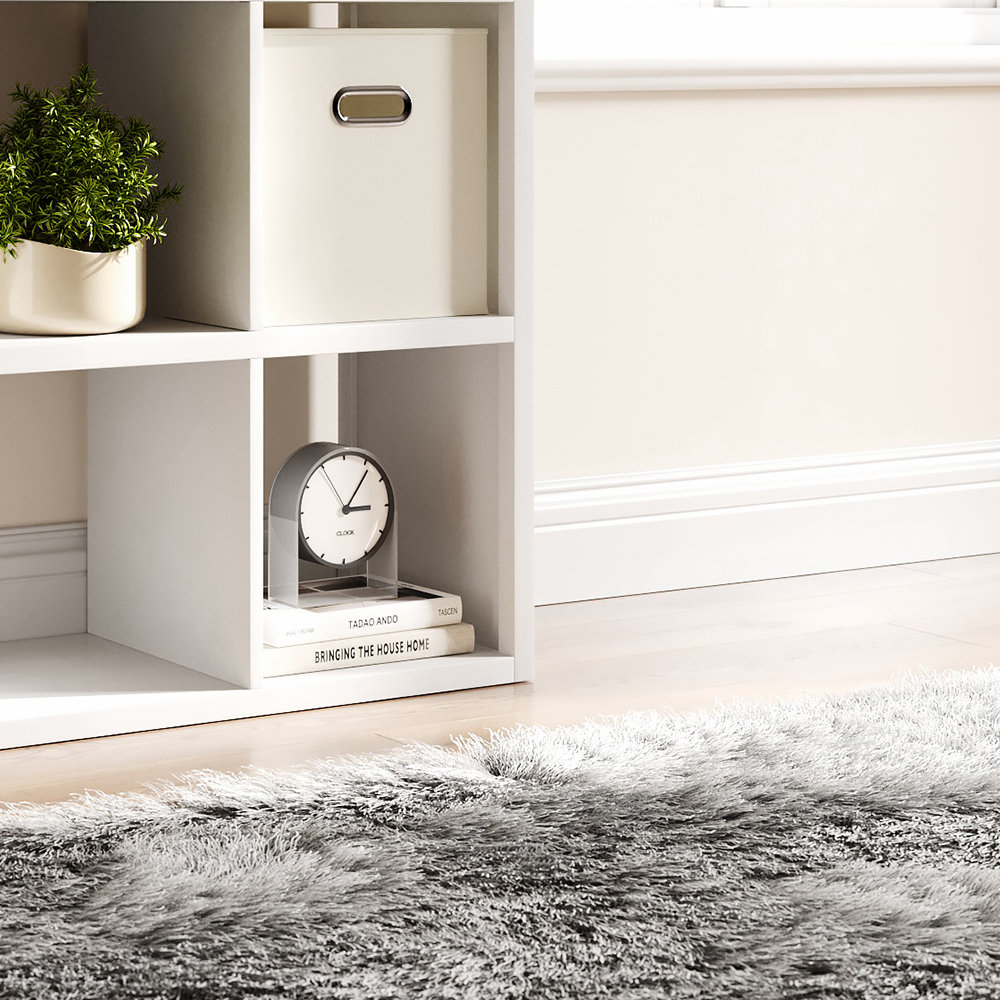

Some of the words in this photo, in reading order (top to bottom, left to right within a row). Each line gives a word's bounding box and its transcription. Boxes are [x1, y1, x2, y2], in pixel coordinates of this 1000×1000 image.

[348, 618, 375, 629] TADAO
[376, 614, 399, 626] ANDO
[314, 646, 356, 664] BRINGING
[358, 644, 374, 657] THE
[377, 640, 404, 656] HOUSE
[406, 638, 430, 651] HOME
